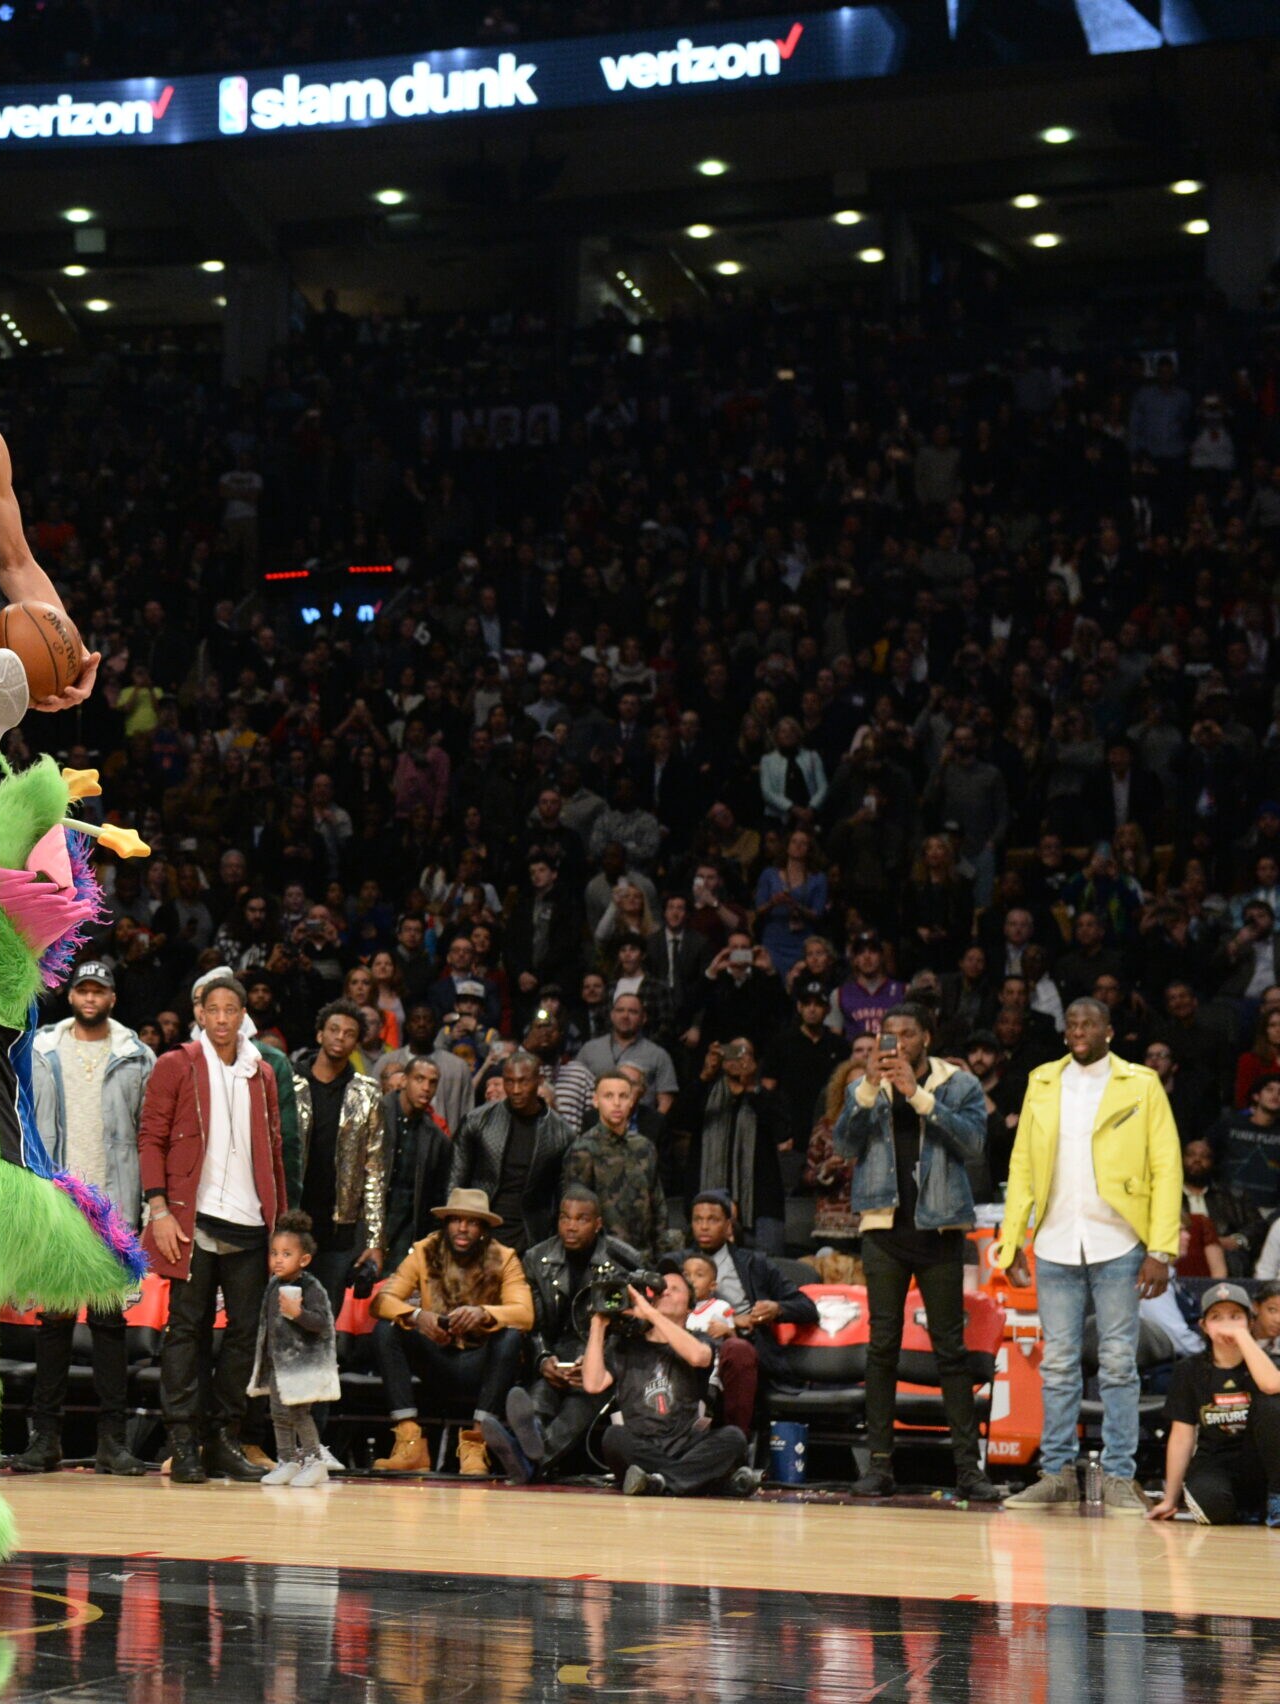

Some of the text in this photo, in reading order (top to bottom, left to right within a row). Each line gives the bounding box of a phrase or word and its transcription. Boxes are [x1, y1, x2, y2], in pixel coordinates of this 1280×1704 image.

[250, 53, 539, 130] slam dunk
[599, 38, 780, 91] verizon
